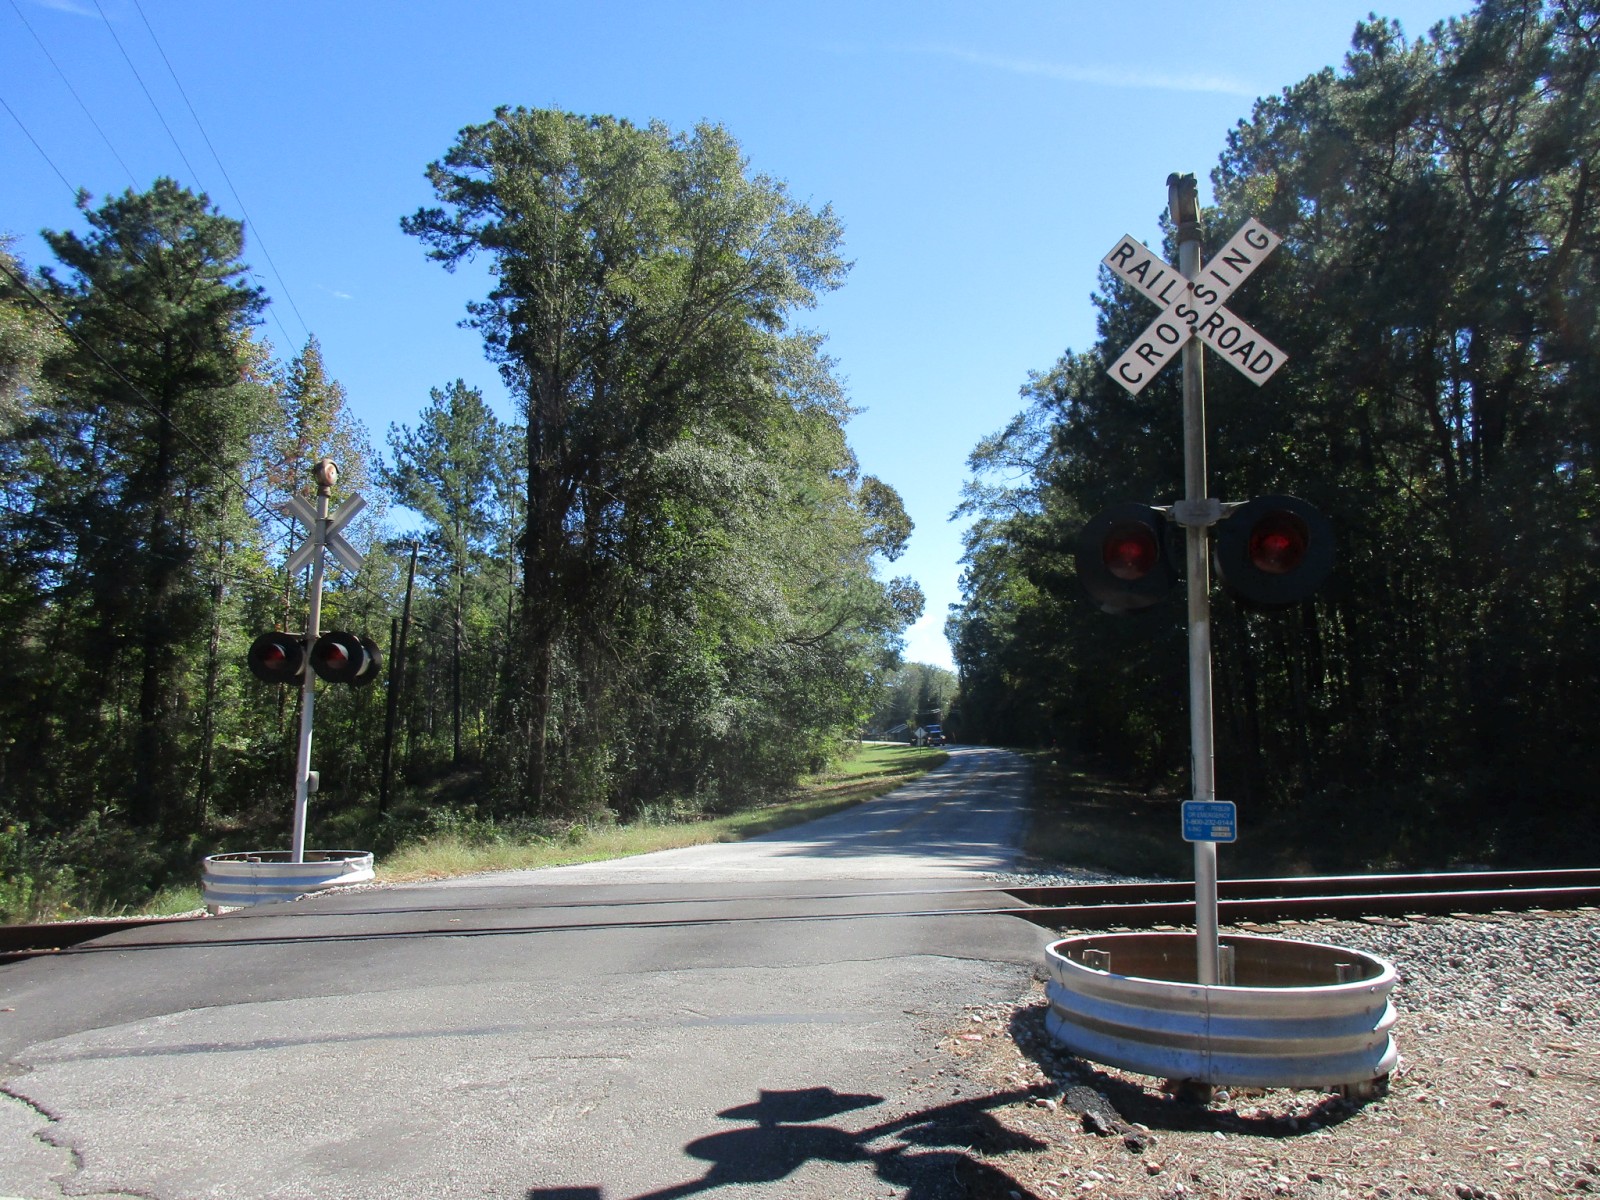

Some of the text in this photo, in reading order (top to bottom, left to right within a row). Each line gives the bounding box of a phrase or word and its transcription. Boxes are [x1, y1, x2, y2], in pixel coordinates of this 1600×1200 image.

[1110, 242, 1274, 375] RAIL ROAD
[1119, 228, 1269, 384] CROSSING
